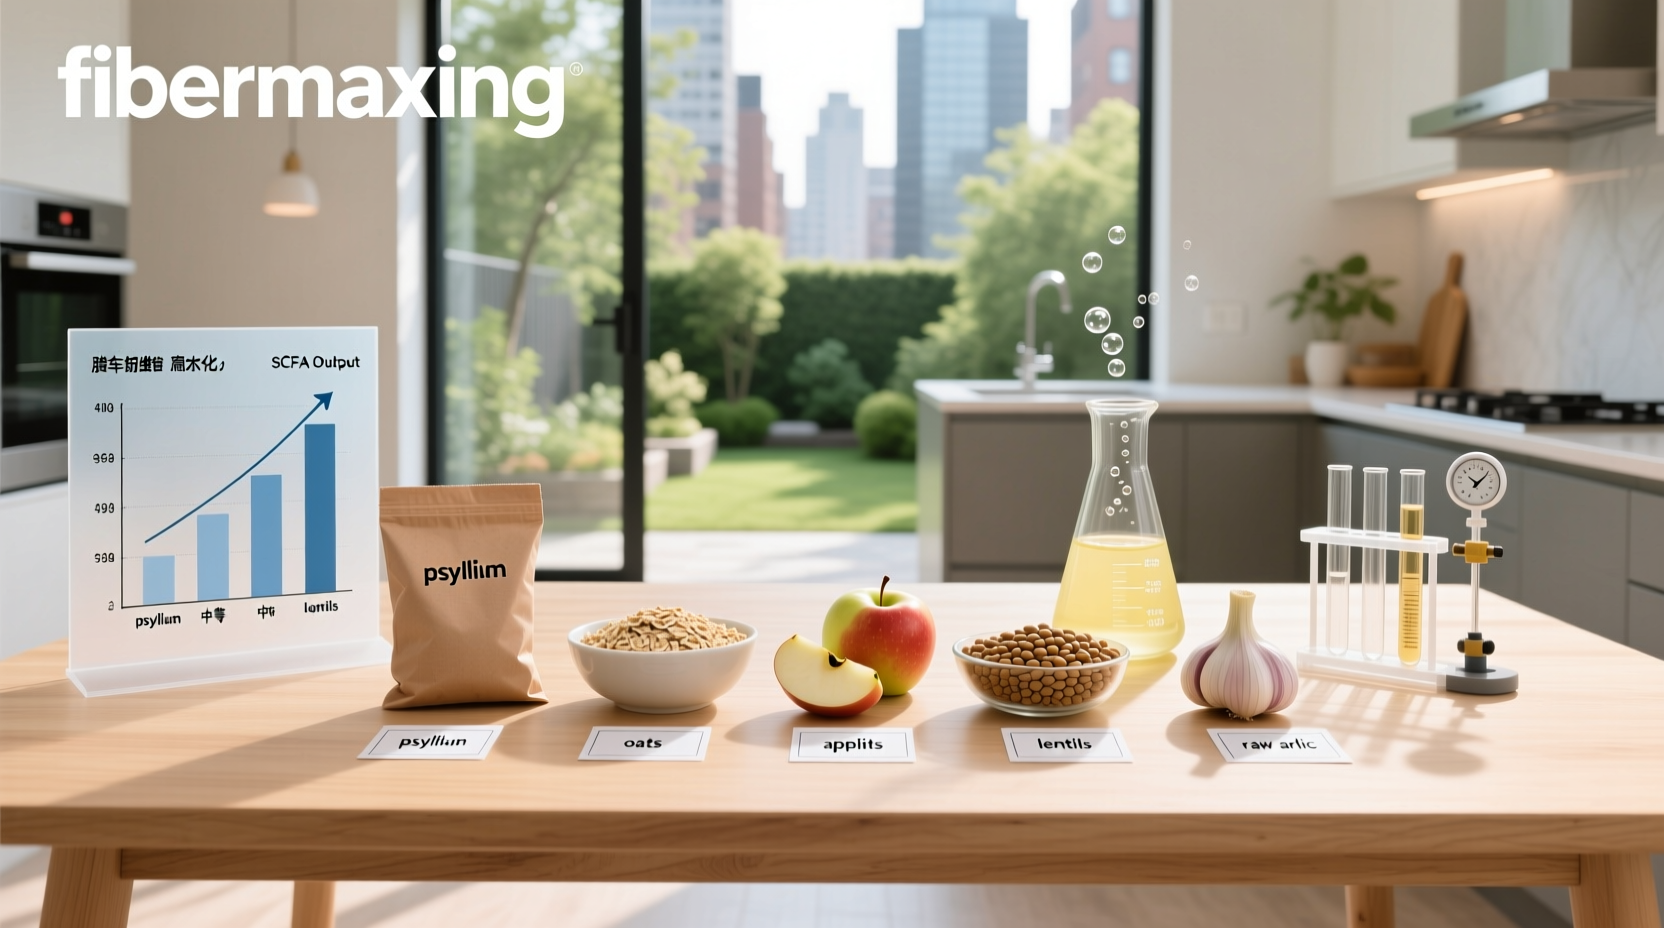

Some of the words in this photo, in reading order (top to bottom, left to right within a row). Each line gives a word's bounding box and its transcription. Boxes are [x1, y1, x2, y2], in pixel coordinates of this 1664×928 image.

[271, 355, 310, 369] SCFA
[623, 738, 662, 748] oats
[823, 737, 883, 753] applits
[1037, 737, 1092, 749] lentils
[1242, 740, 1272, 750] raw
